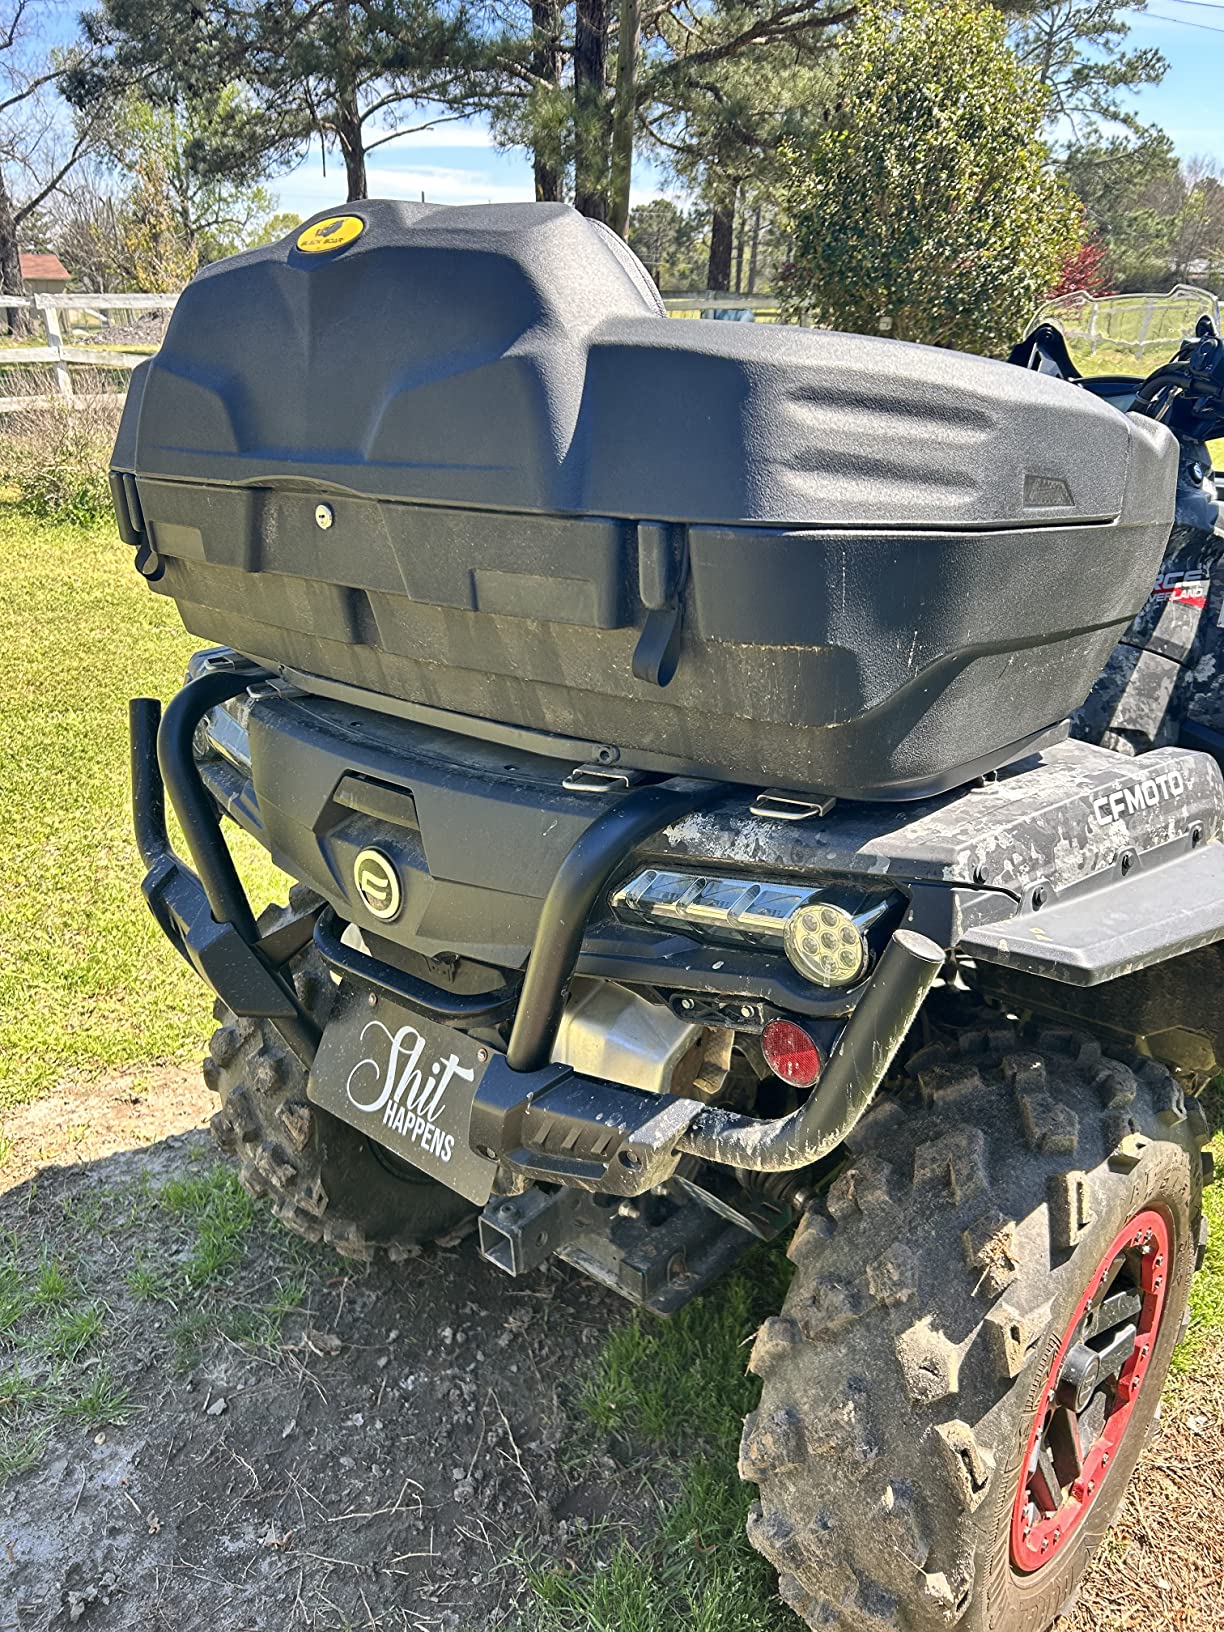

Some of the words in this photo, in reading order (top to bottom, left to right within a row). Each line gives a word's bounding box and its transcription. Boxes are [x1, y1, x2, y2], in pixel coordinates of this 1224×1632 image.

[1093, 770, 1184, 826] CFMOTO
[346, 1020, 475, 1122] Shit
[382, 1100, 455, 1162] HAPPENS
